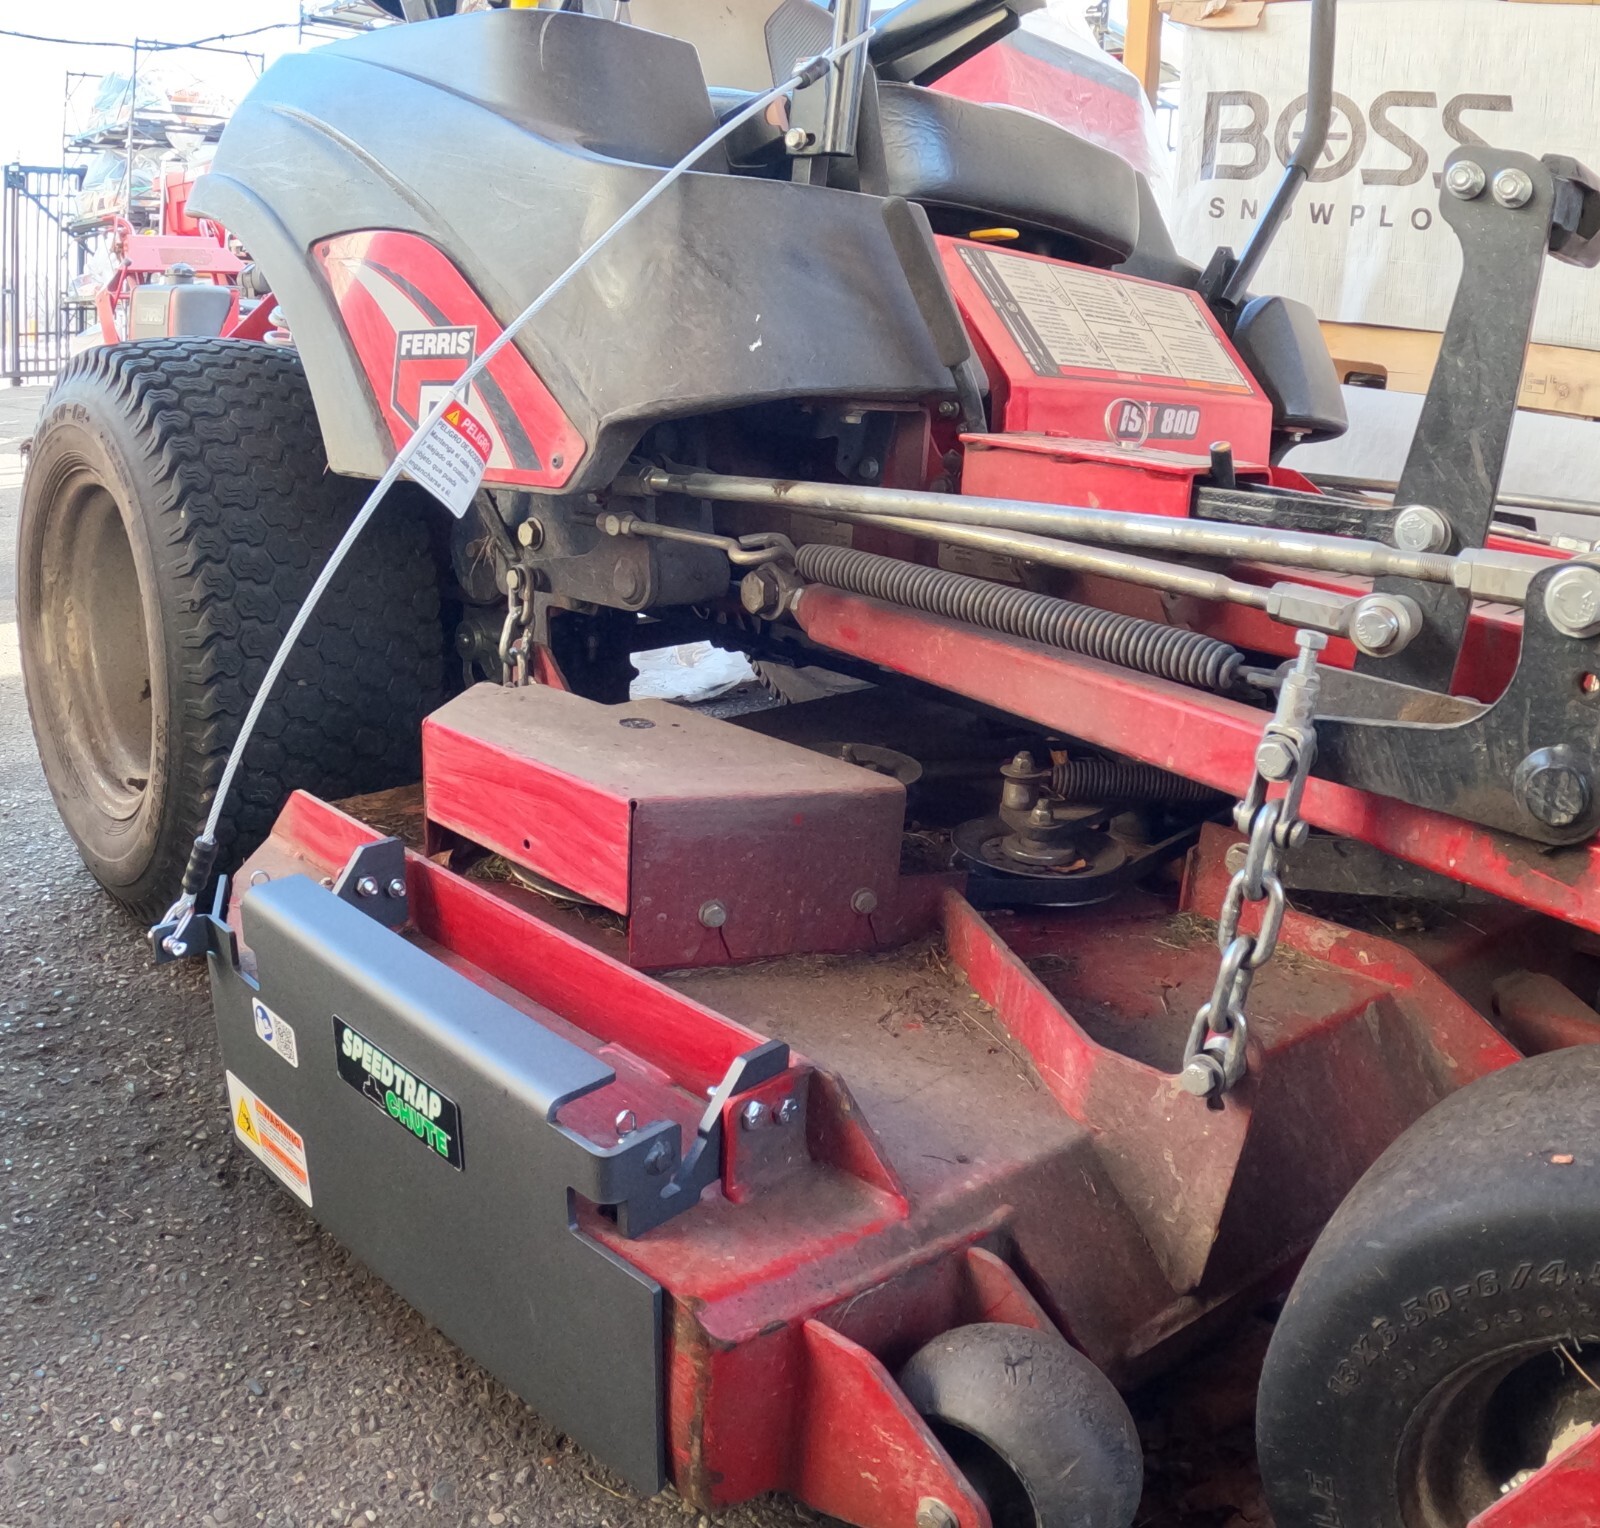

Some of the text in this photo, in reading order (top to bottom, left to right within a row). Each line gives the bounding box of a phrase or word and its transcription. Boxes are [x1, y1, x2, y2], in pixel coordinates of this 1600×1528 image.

[1200, 90, 1514, 189] BOSS
[400, 331, 471, 356] FERRIS
[437, 420, 461, 444] PELIGRO
[461, 441, 469, 451] DE
[1161, 408, 1200, 436] 800
[426, 443, 446, 462] alejado
[446, 460, 453, 468] de
[430, 430, 455, 454] Mantenga
[408, 459, 442, 489] engancharse
[415, 450, 432, 465] objeto
[432, 463, 443, 474] que
[341, 1027, 442, 1121] SPEEDTRAP
[385, 1089, 449, 1158] CHUTE
